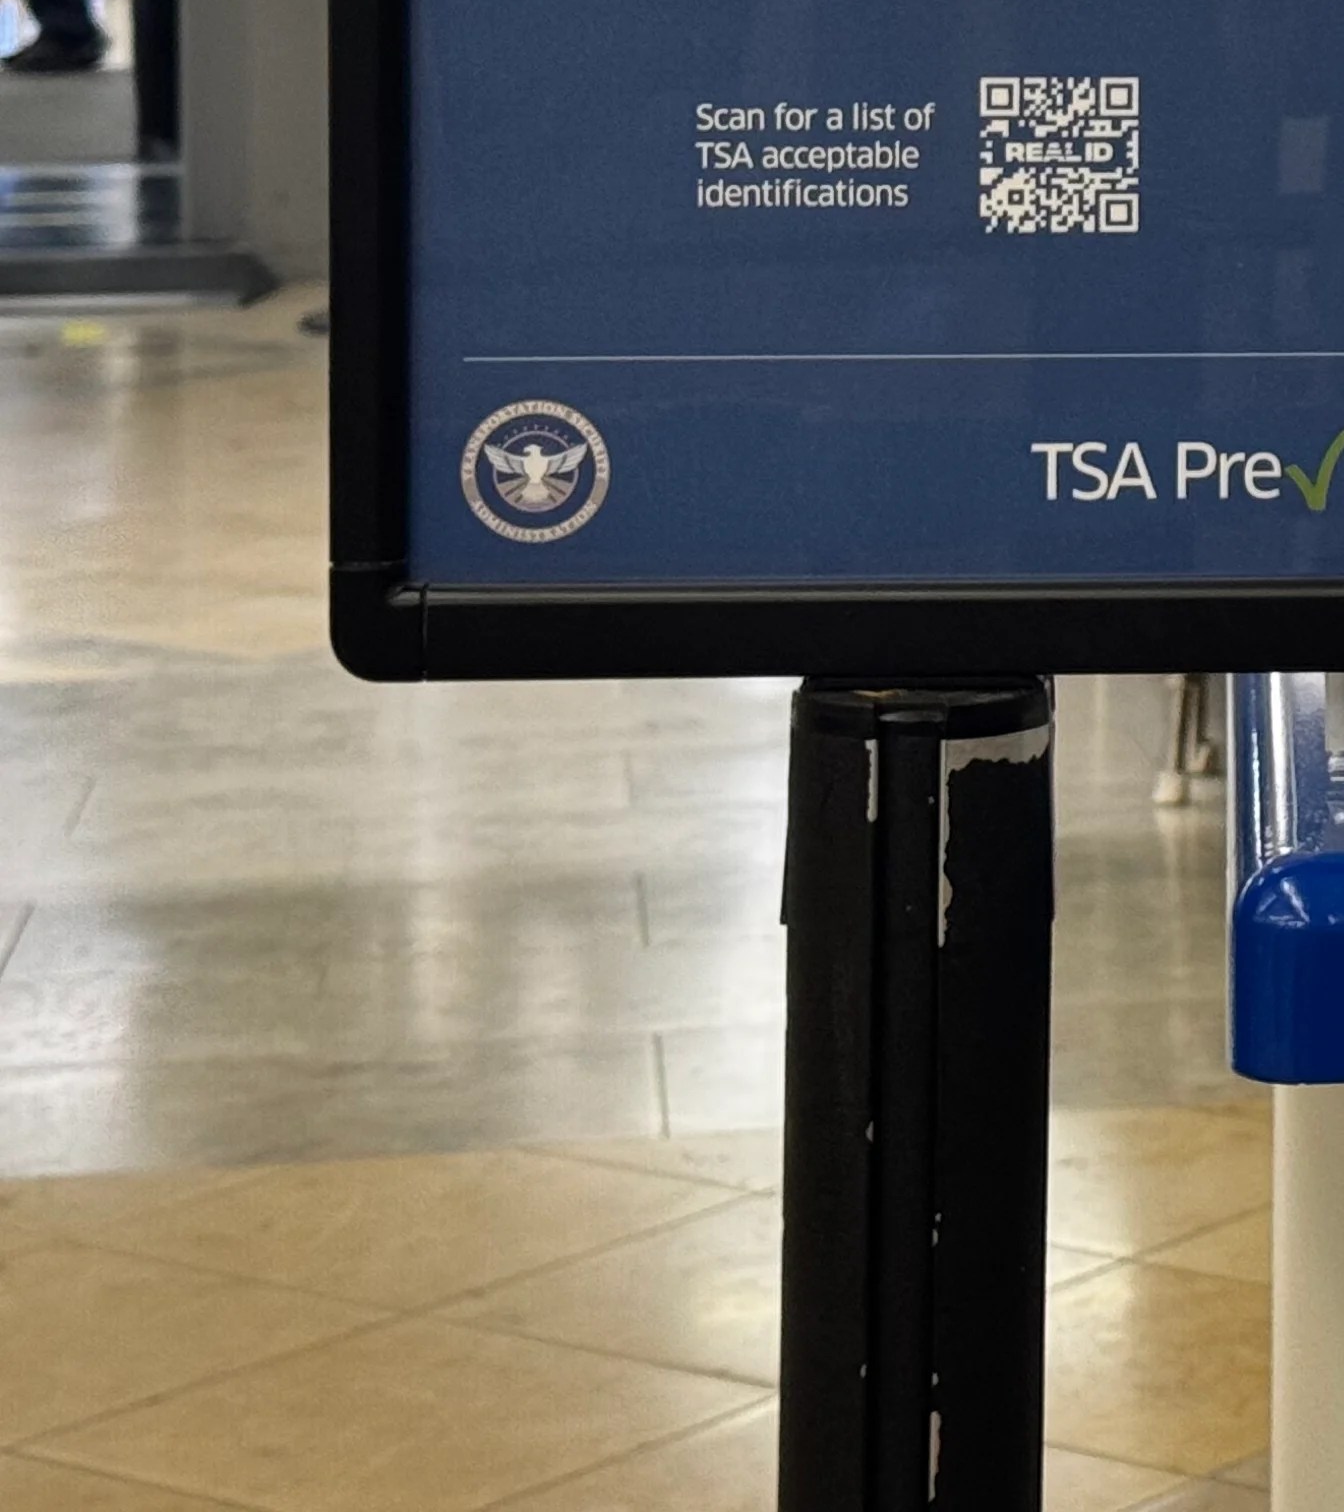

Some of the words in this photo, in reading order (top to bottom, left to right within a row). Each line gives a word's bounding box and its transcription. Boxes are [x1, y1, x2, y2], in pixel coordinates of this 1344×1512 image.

[697, 104, 765, 130] Scan
[774, 103, 818, 130] for
[827, 108, 842, 130] a
[853, 102, 895, 130] list
[904, 103, 935, 130] of
[695, 142, 753, 168] TSA
[763, 140, 919, 173] acceptable
[1006, 142, 1082, 162] REAL
[1086, 142, 1113, 162] ID
[698, 178, 908, 207] identifications
[1031, 442, 1156, 500] TSA
